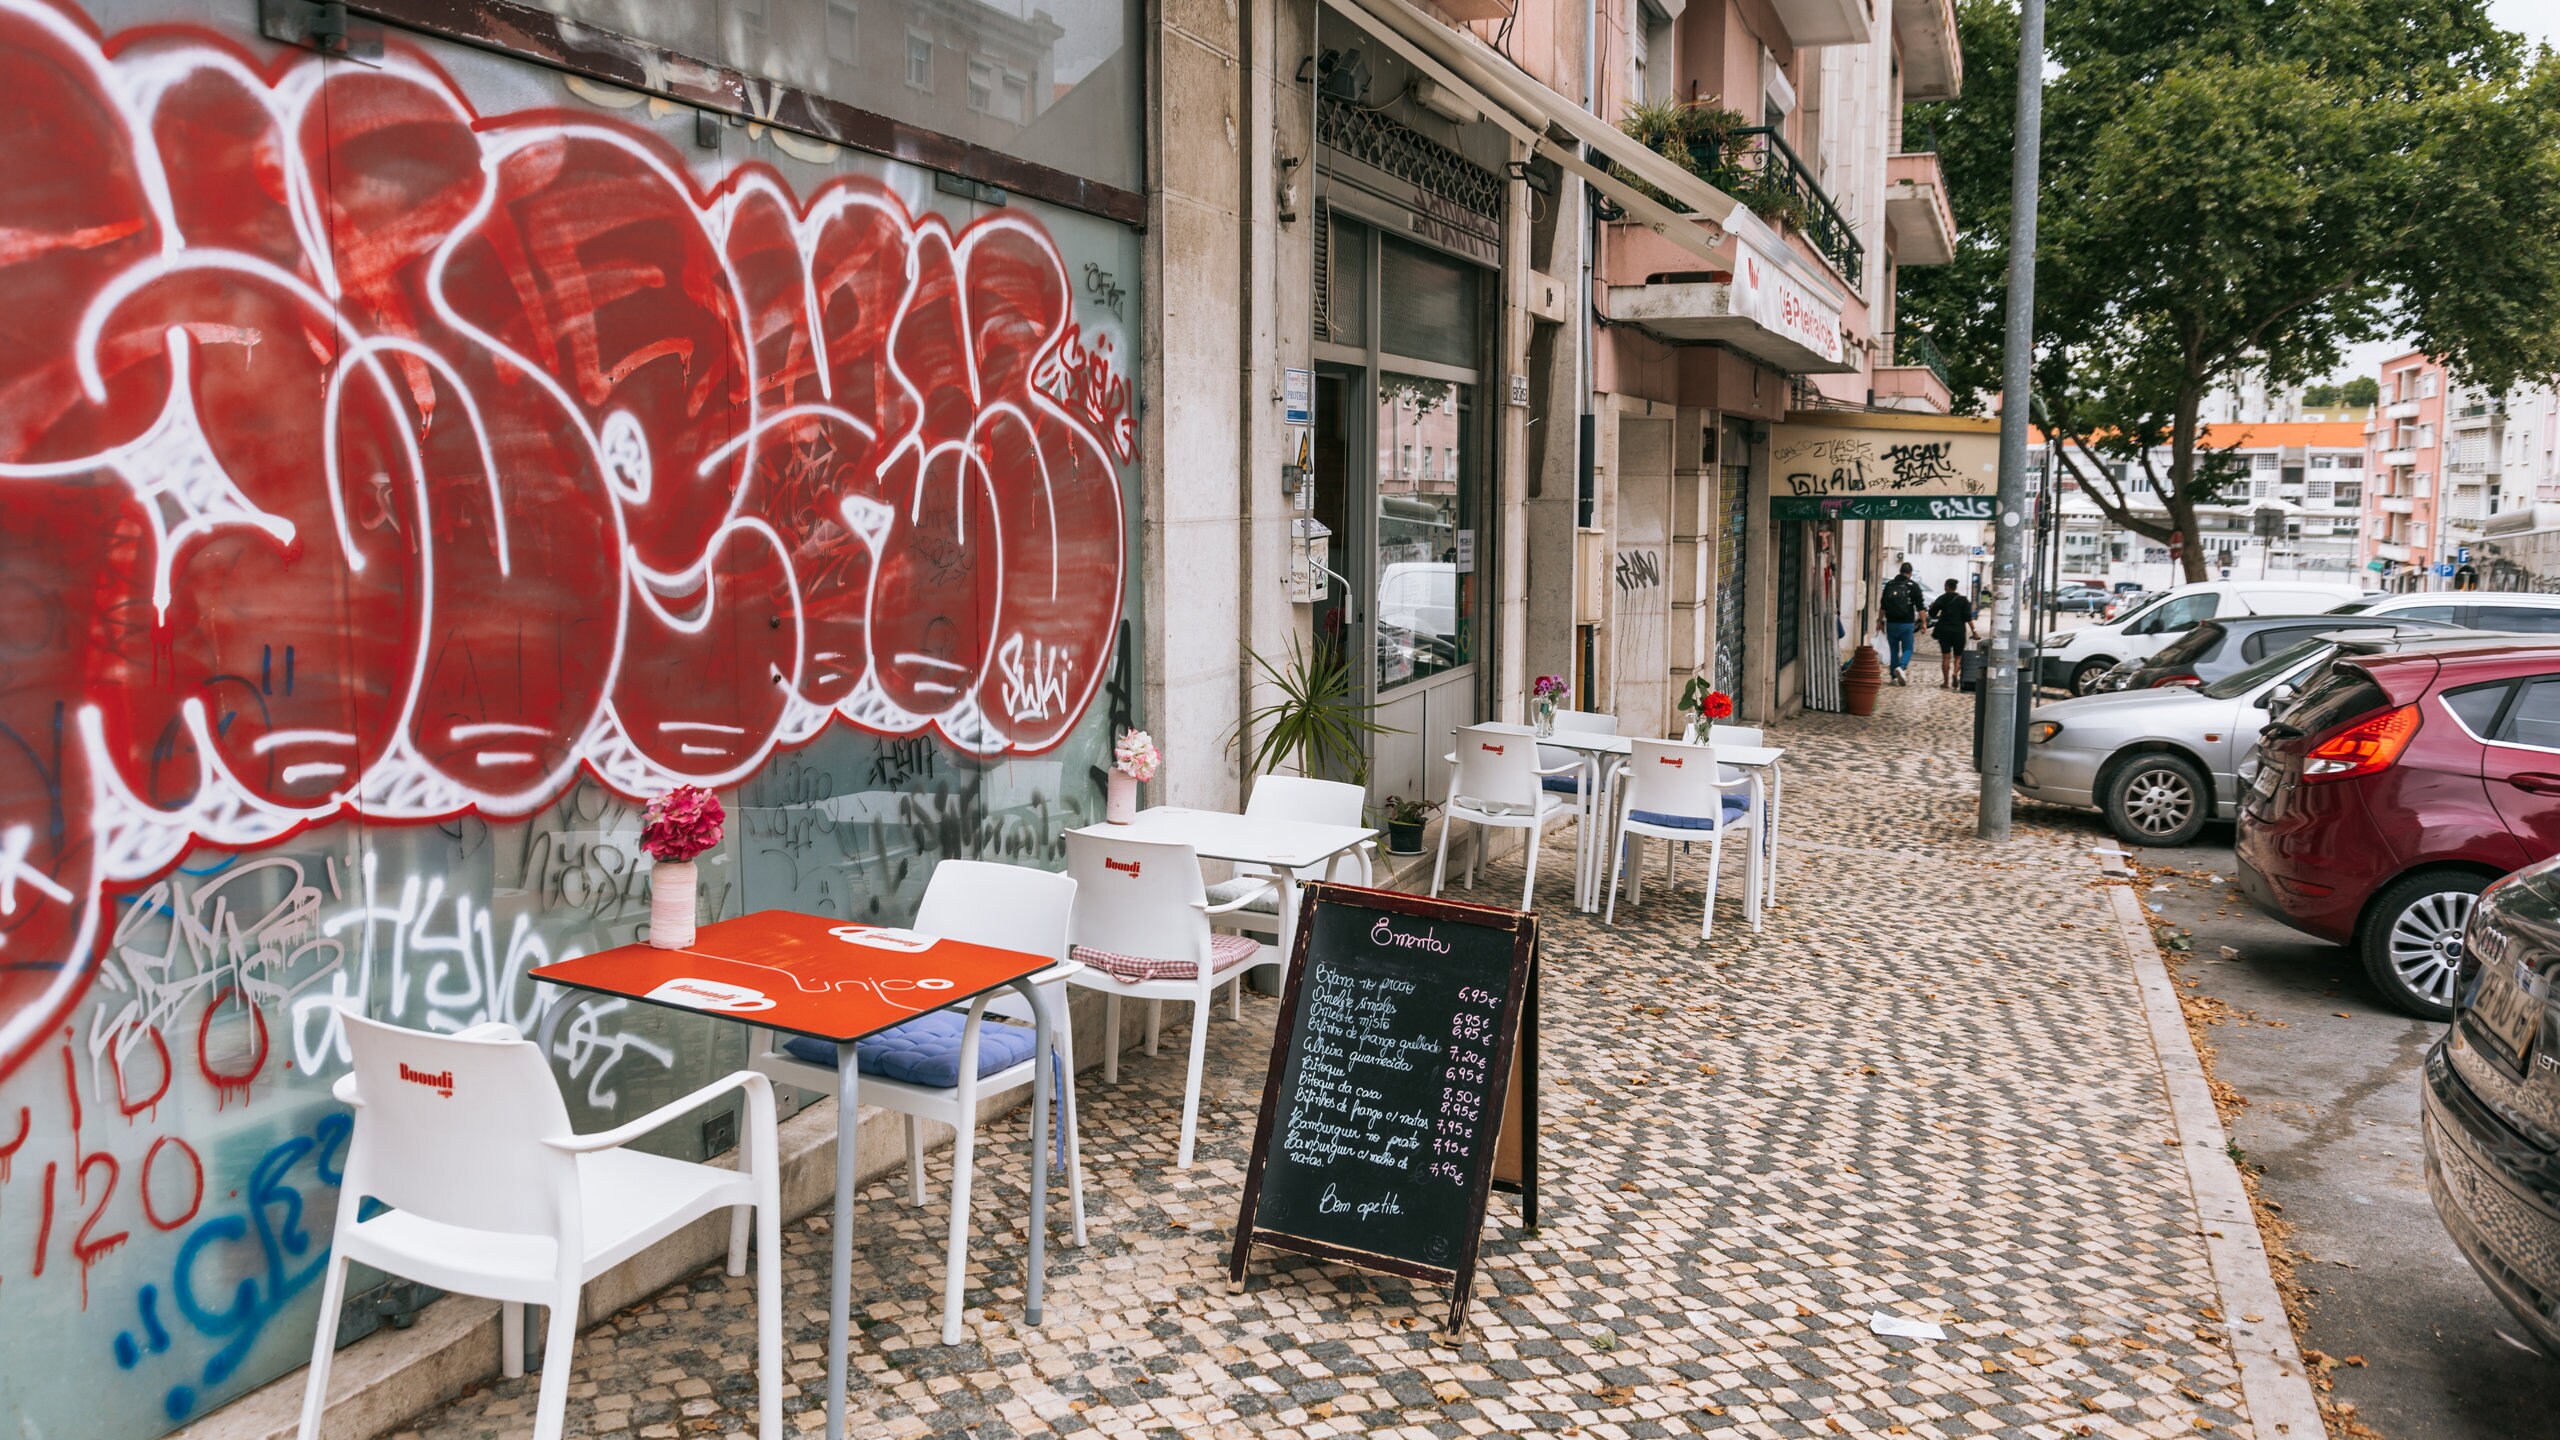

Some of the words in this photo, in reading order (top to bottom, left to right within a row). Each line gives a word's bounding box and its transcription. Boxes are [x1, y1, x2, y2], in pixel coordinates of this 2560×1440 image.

[1930, 533, 1960, 544] ROMA
[1105, 857, 1140, 873] Buondi
[1370, 916, 1451, 955] Ementa
[669, 983, 742, 1002] Buondi
[1312, 984, 1354, 1011] Omelete
[1354, 997, 1398, 1017] simples
[1315, 963, 1355, 994] Bifana
[1359, 980, 1377, 991] no
[1377, 977, 1417, 1000] prato
[1458, 986, 1499, 1009] 6,95€
[1309, 1002, 1355, 1025] Omelete
[1358, 1013, 1391, 1031] misto
[1303, 1035, 1344, 1059] Alheira
[1348, 1048, 1414, 1073] guarnecida
[1445, 1066, 1484, 1084] 6,95€
[1307, 1015, 1343, 1042] Bifinho
[1345, 1027, 1358, 1040] de
[1359, 1029, 1397, 1059] frango
[1398, 1034, 1443, 1059] grelhado
[1449, 1045, 1487, 1070] 7,20€
[399, 1062, 454, 1089] Buondi
[1298, 1070, 1335, 1097] Bitoque
[1338, 1081, 1353, 1095] da
[1355, 1087, 1383, 1100] casa
[1439, 1101, 1479, 1123] 8,95€
[1301, 1054, 1346, 1081] Bitoque
[1442, 1086, 1481, 1107] 8,50€
[1287, 1105, 1361, 1144] Hamburguer
[1366, 1132, 1381, 1142] no
[1387, 1130, 1421, 1151] prato
[1294, 1086, 1336, 1114] Bifinhos
[1336, 1100, 1348, 1114] de
[1350, 1099, 1384, 1130] frango
[1436, 1119, 1473, 1139] 7,95€
[1283, 1128, 1356, 1165] Hamburguer
[1397, 1155, 1409, 1170] de
[1428, 1161, 1465, 1186] 7,95€
[1318, 1182, 1352, 1215] Bom
